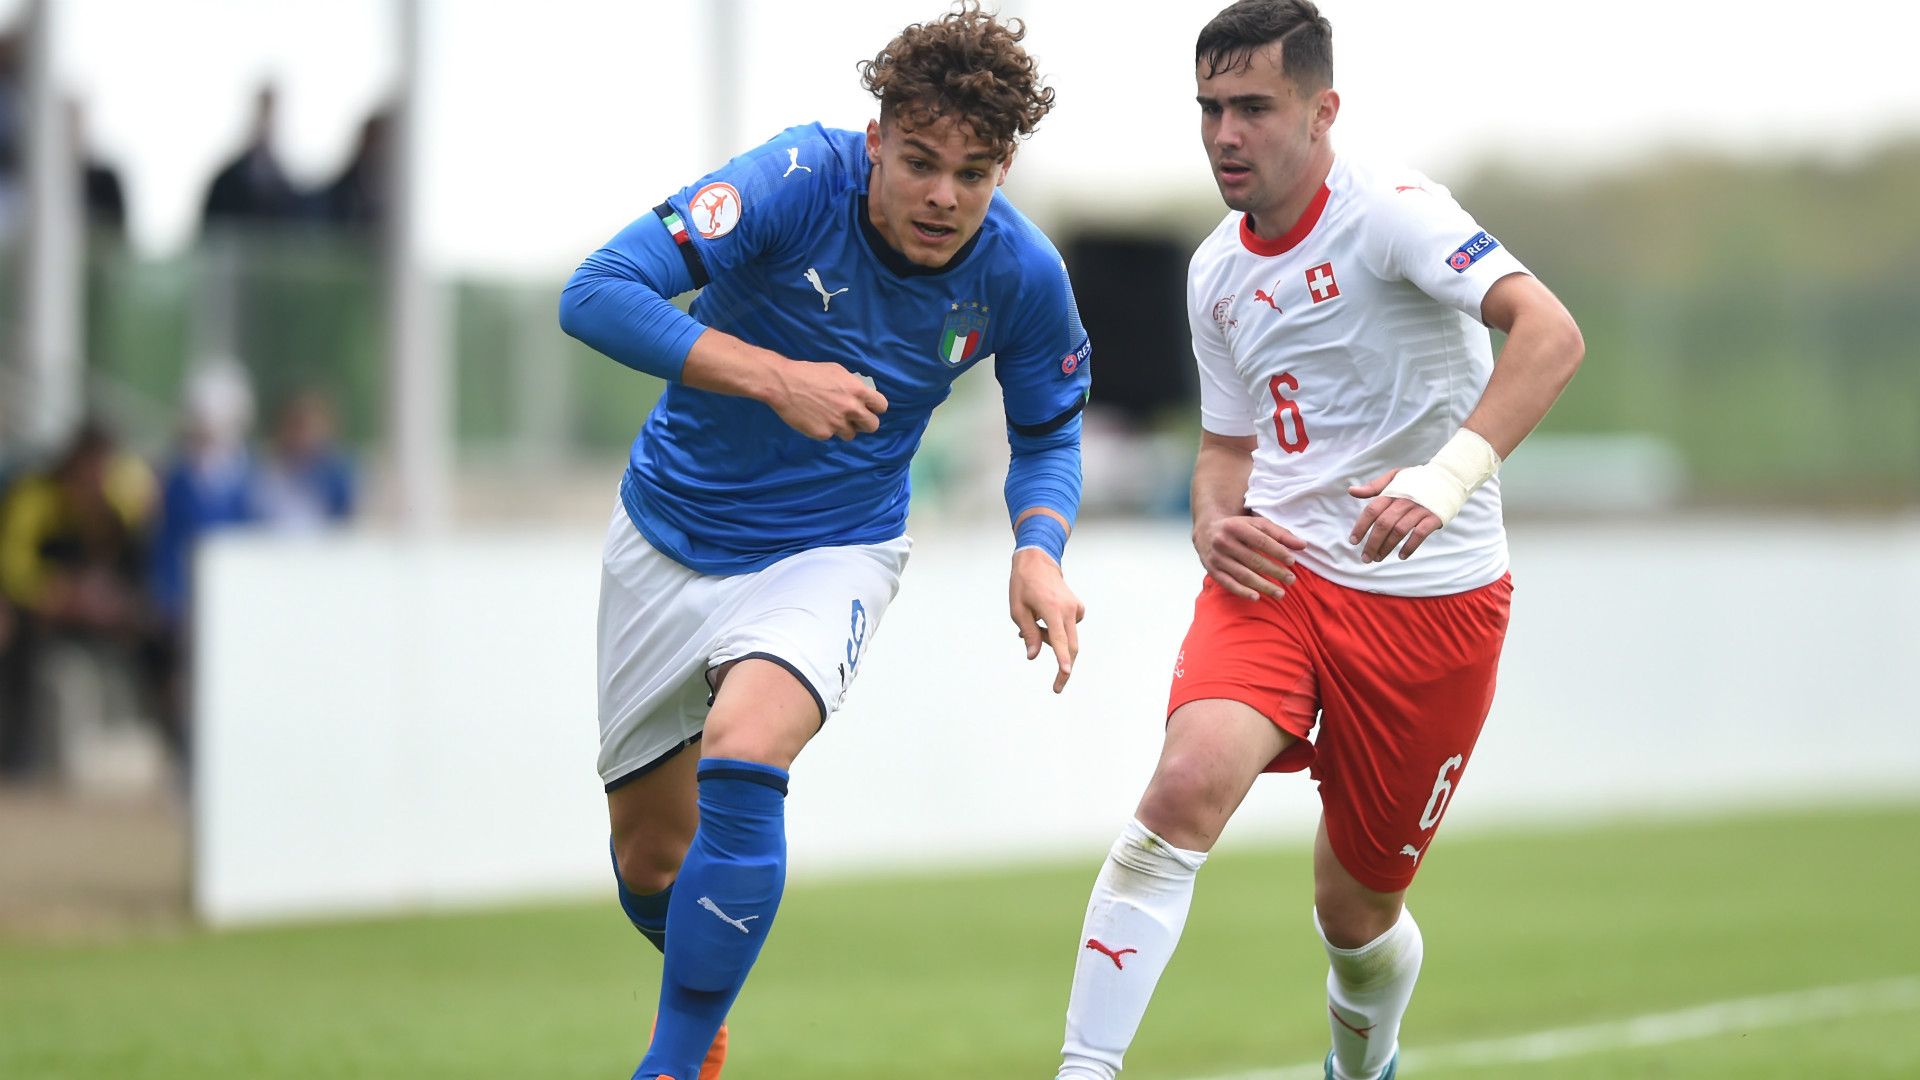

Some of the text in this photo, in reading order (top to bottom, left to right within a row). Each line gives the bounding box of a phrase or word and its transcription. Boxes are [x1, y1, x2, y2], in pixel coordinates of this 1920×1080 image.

[1268, 372, 1310, 454] 6
[847, 599, 867, 673] 9
[1418, 753, 1463, 831] 6
